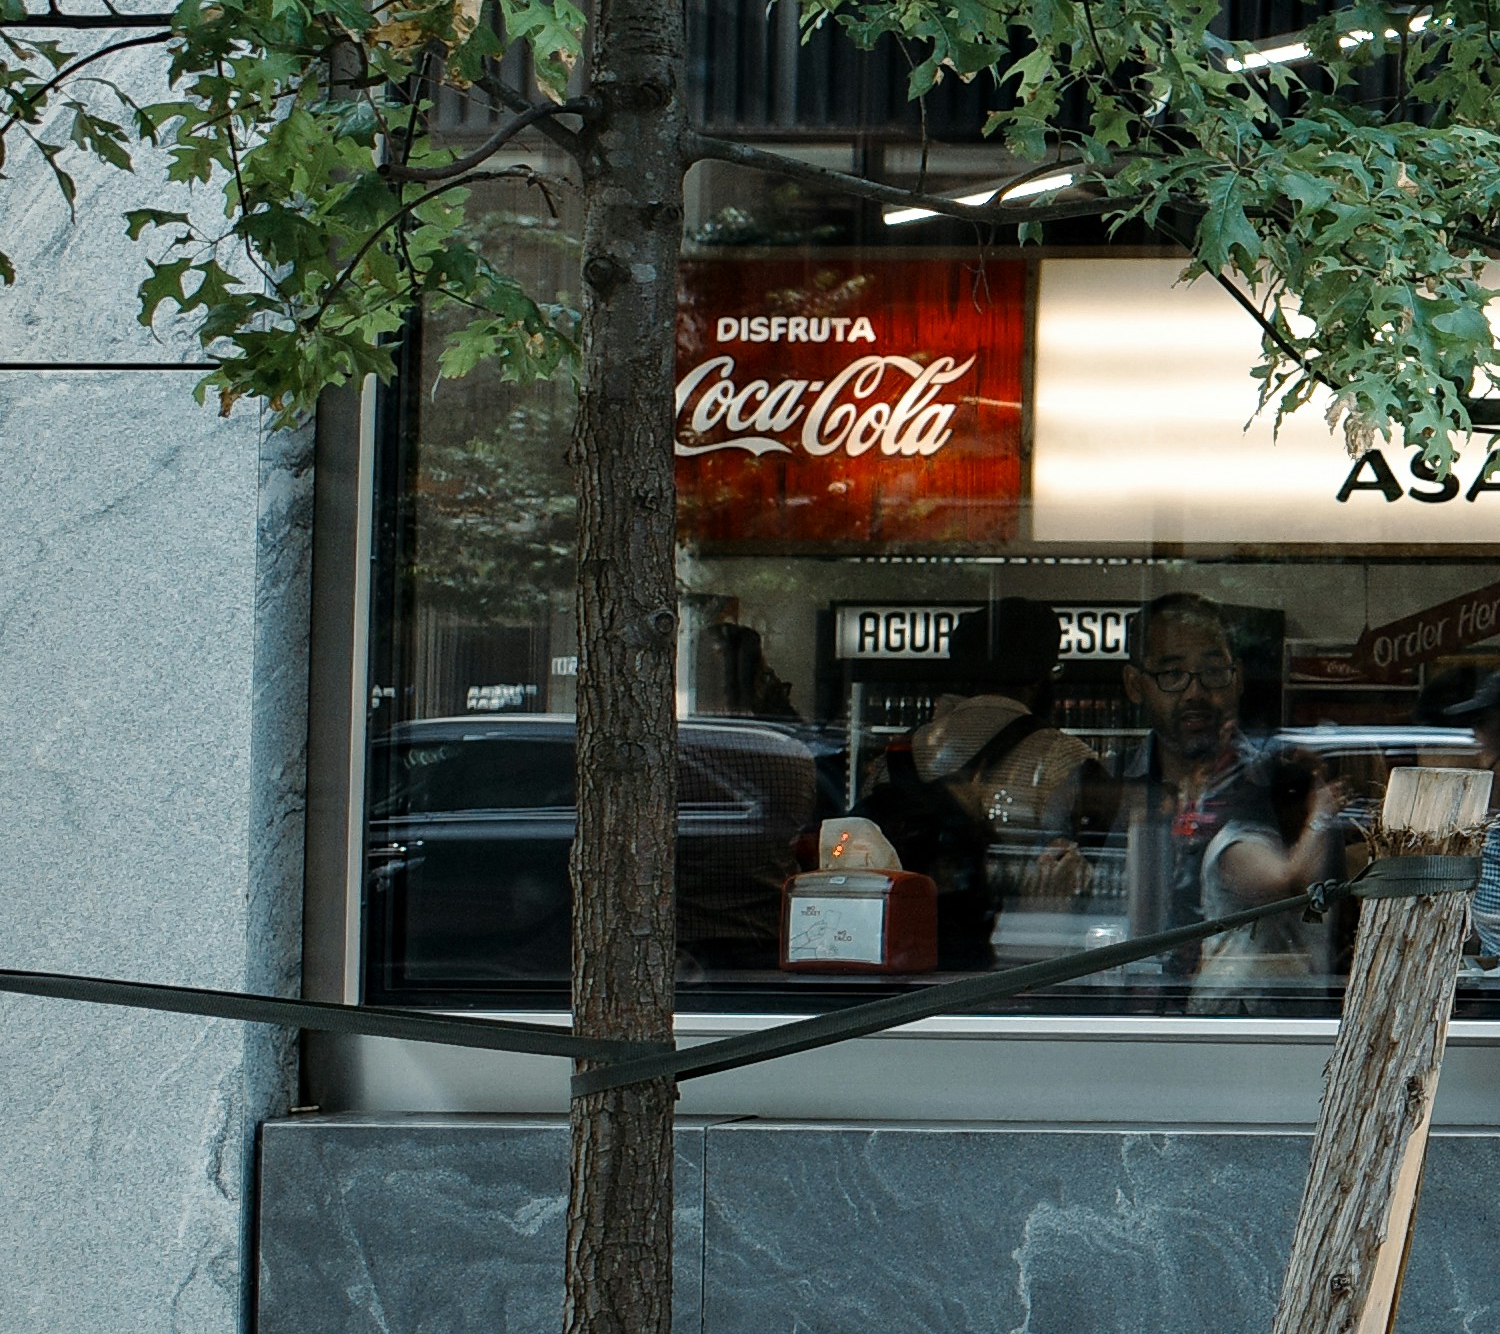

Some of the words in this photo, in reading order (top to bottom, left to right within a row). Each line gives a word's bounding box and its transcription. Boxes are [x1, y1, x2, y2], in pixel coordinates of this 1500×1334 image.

[717, 317, 877, 343] DISFRUTA
[675, 354, 977, 458] Coca-Cola
[858, 611, 966, 654] AGUA
[1372, 617, 1448, 668] Order
